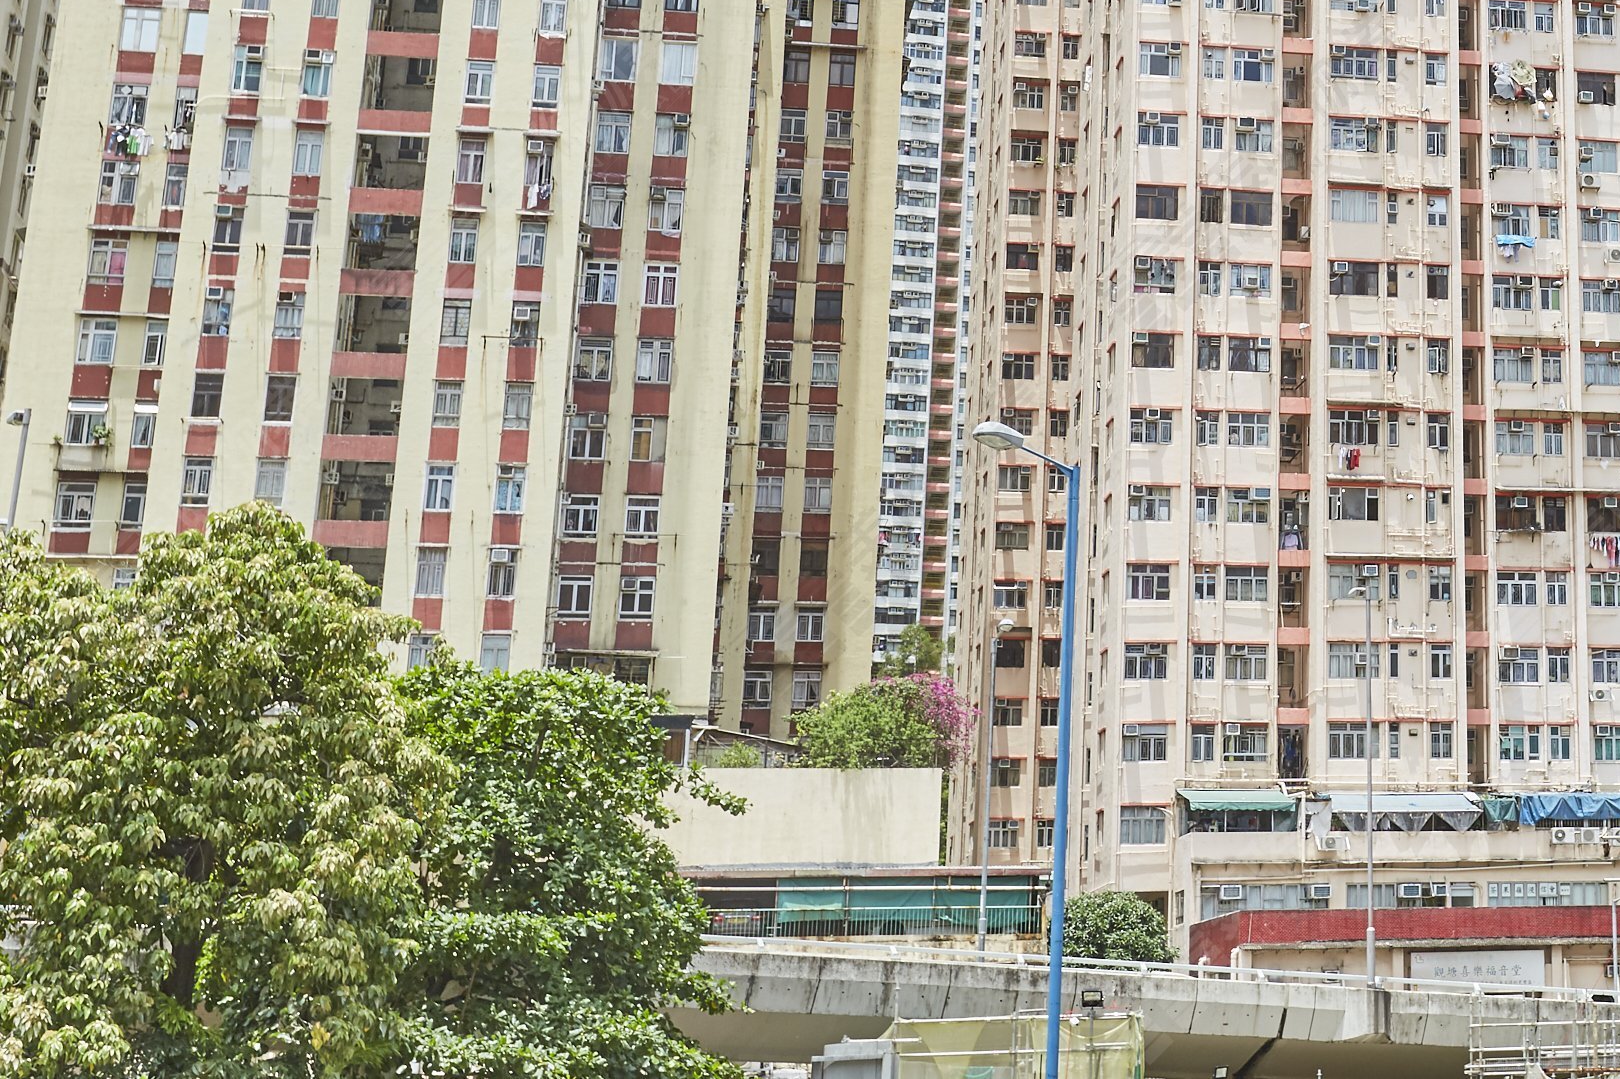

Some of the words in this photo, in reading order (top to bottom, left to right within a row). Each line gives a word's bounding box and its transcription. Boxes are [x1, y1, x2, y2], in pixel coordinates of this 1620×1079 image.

[1434, 964, 1522, 978] 觀塘喜樂福音堂
